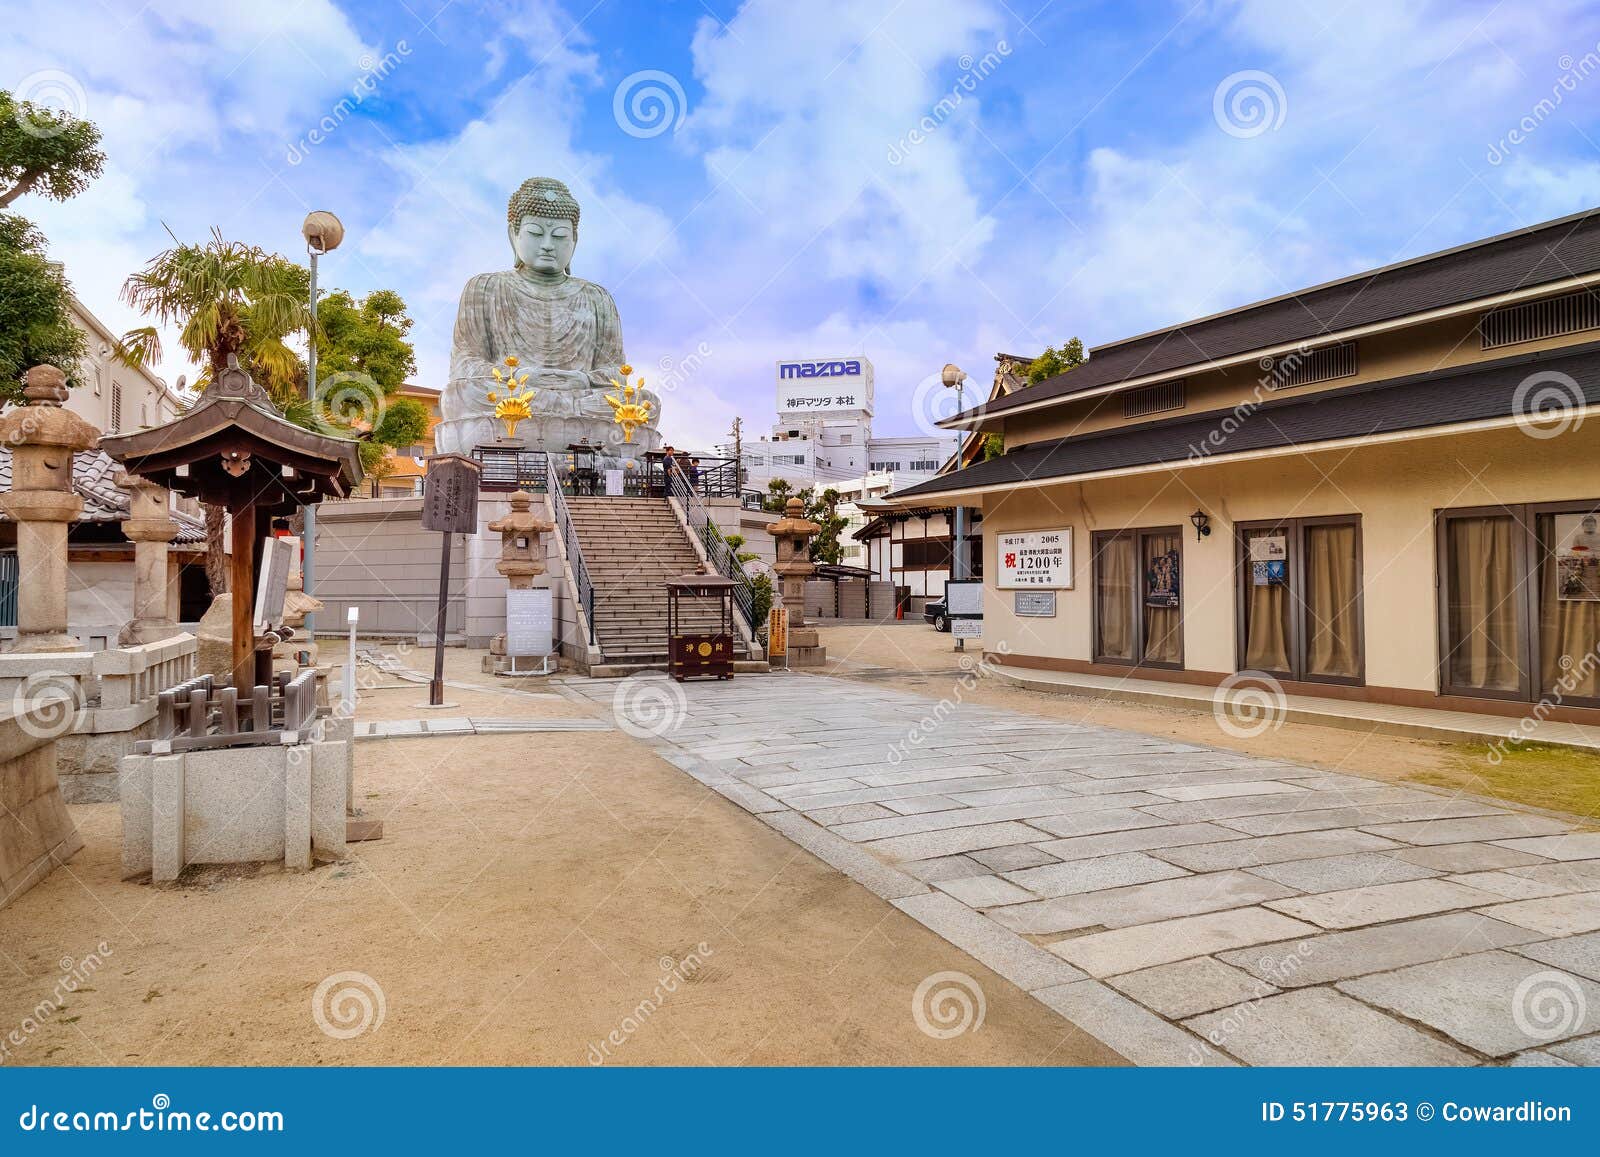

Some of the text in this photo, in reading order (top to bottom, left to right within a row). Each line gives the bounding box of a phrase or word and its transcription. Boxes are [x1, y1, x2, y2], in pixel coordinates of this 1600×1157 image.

[786, 395, 856, 408] 神戸マツダ 本社
[1041, 535, 1060, 544] 2005
[1005, 552, 1017, 569] 祝
[1019, 556, 1063, 569] 1200年
